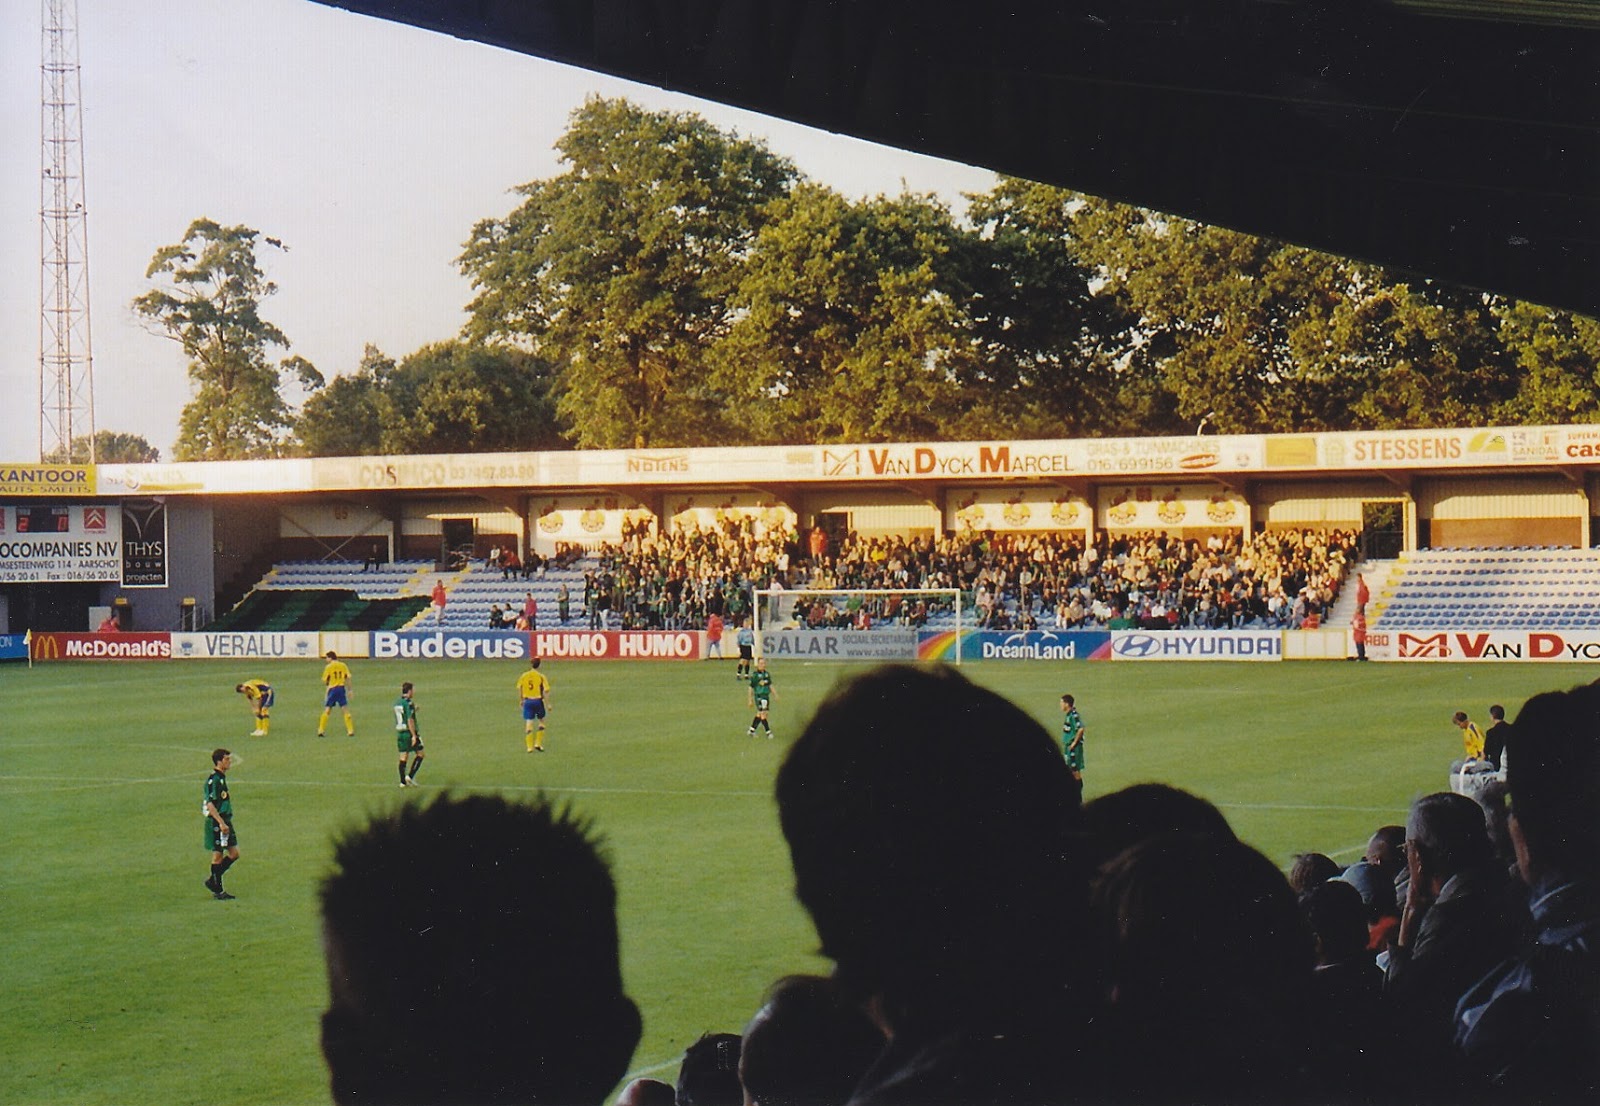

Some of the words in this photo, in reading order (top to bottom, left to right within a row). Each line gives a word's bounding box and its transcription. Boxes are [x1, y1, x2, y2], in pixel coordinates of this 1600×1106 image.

[1354, 437, 1461, 461] STESSENS
[868, 449, 910, 474] VAN
[915, 447, 974, 474] DYCK
[980, 446, 1075, 472] MARCEL
[18, 517, 29, 532] 2
[0, 542, 92, 559] OCOMPANIES
[96, 541, 118, 557] NV
[125, 541, 163, 556] THYS
[57, 560, 72, 569] 114
[78, 559, 119, 569] AARSCHOT
[125, 573, 163, 583] projecten
[66, 639, 171, 657] McDonald's
[205, 634, 285, 656] VERALU
[374, 632, 524, 659] Buderus
[536, 634, 608, 657] HUMO
[619, 633, 693, 657] HUMO
[762, 636, 840, 654] SALAR
[983, 641, 1076, 660] DreamLand
[1163, 637, 1281, 656] HYUNDAI
[1456, 633, 1522, 658] VAN
